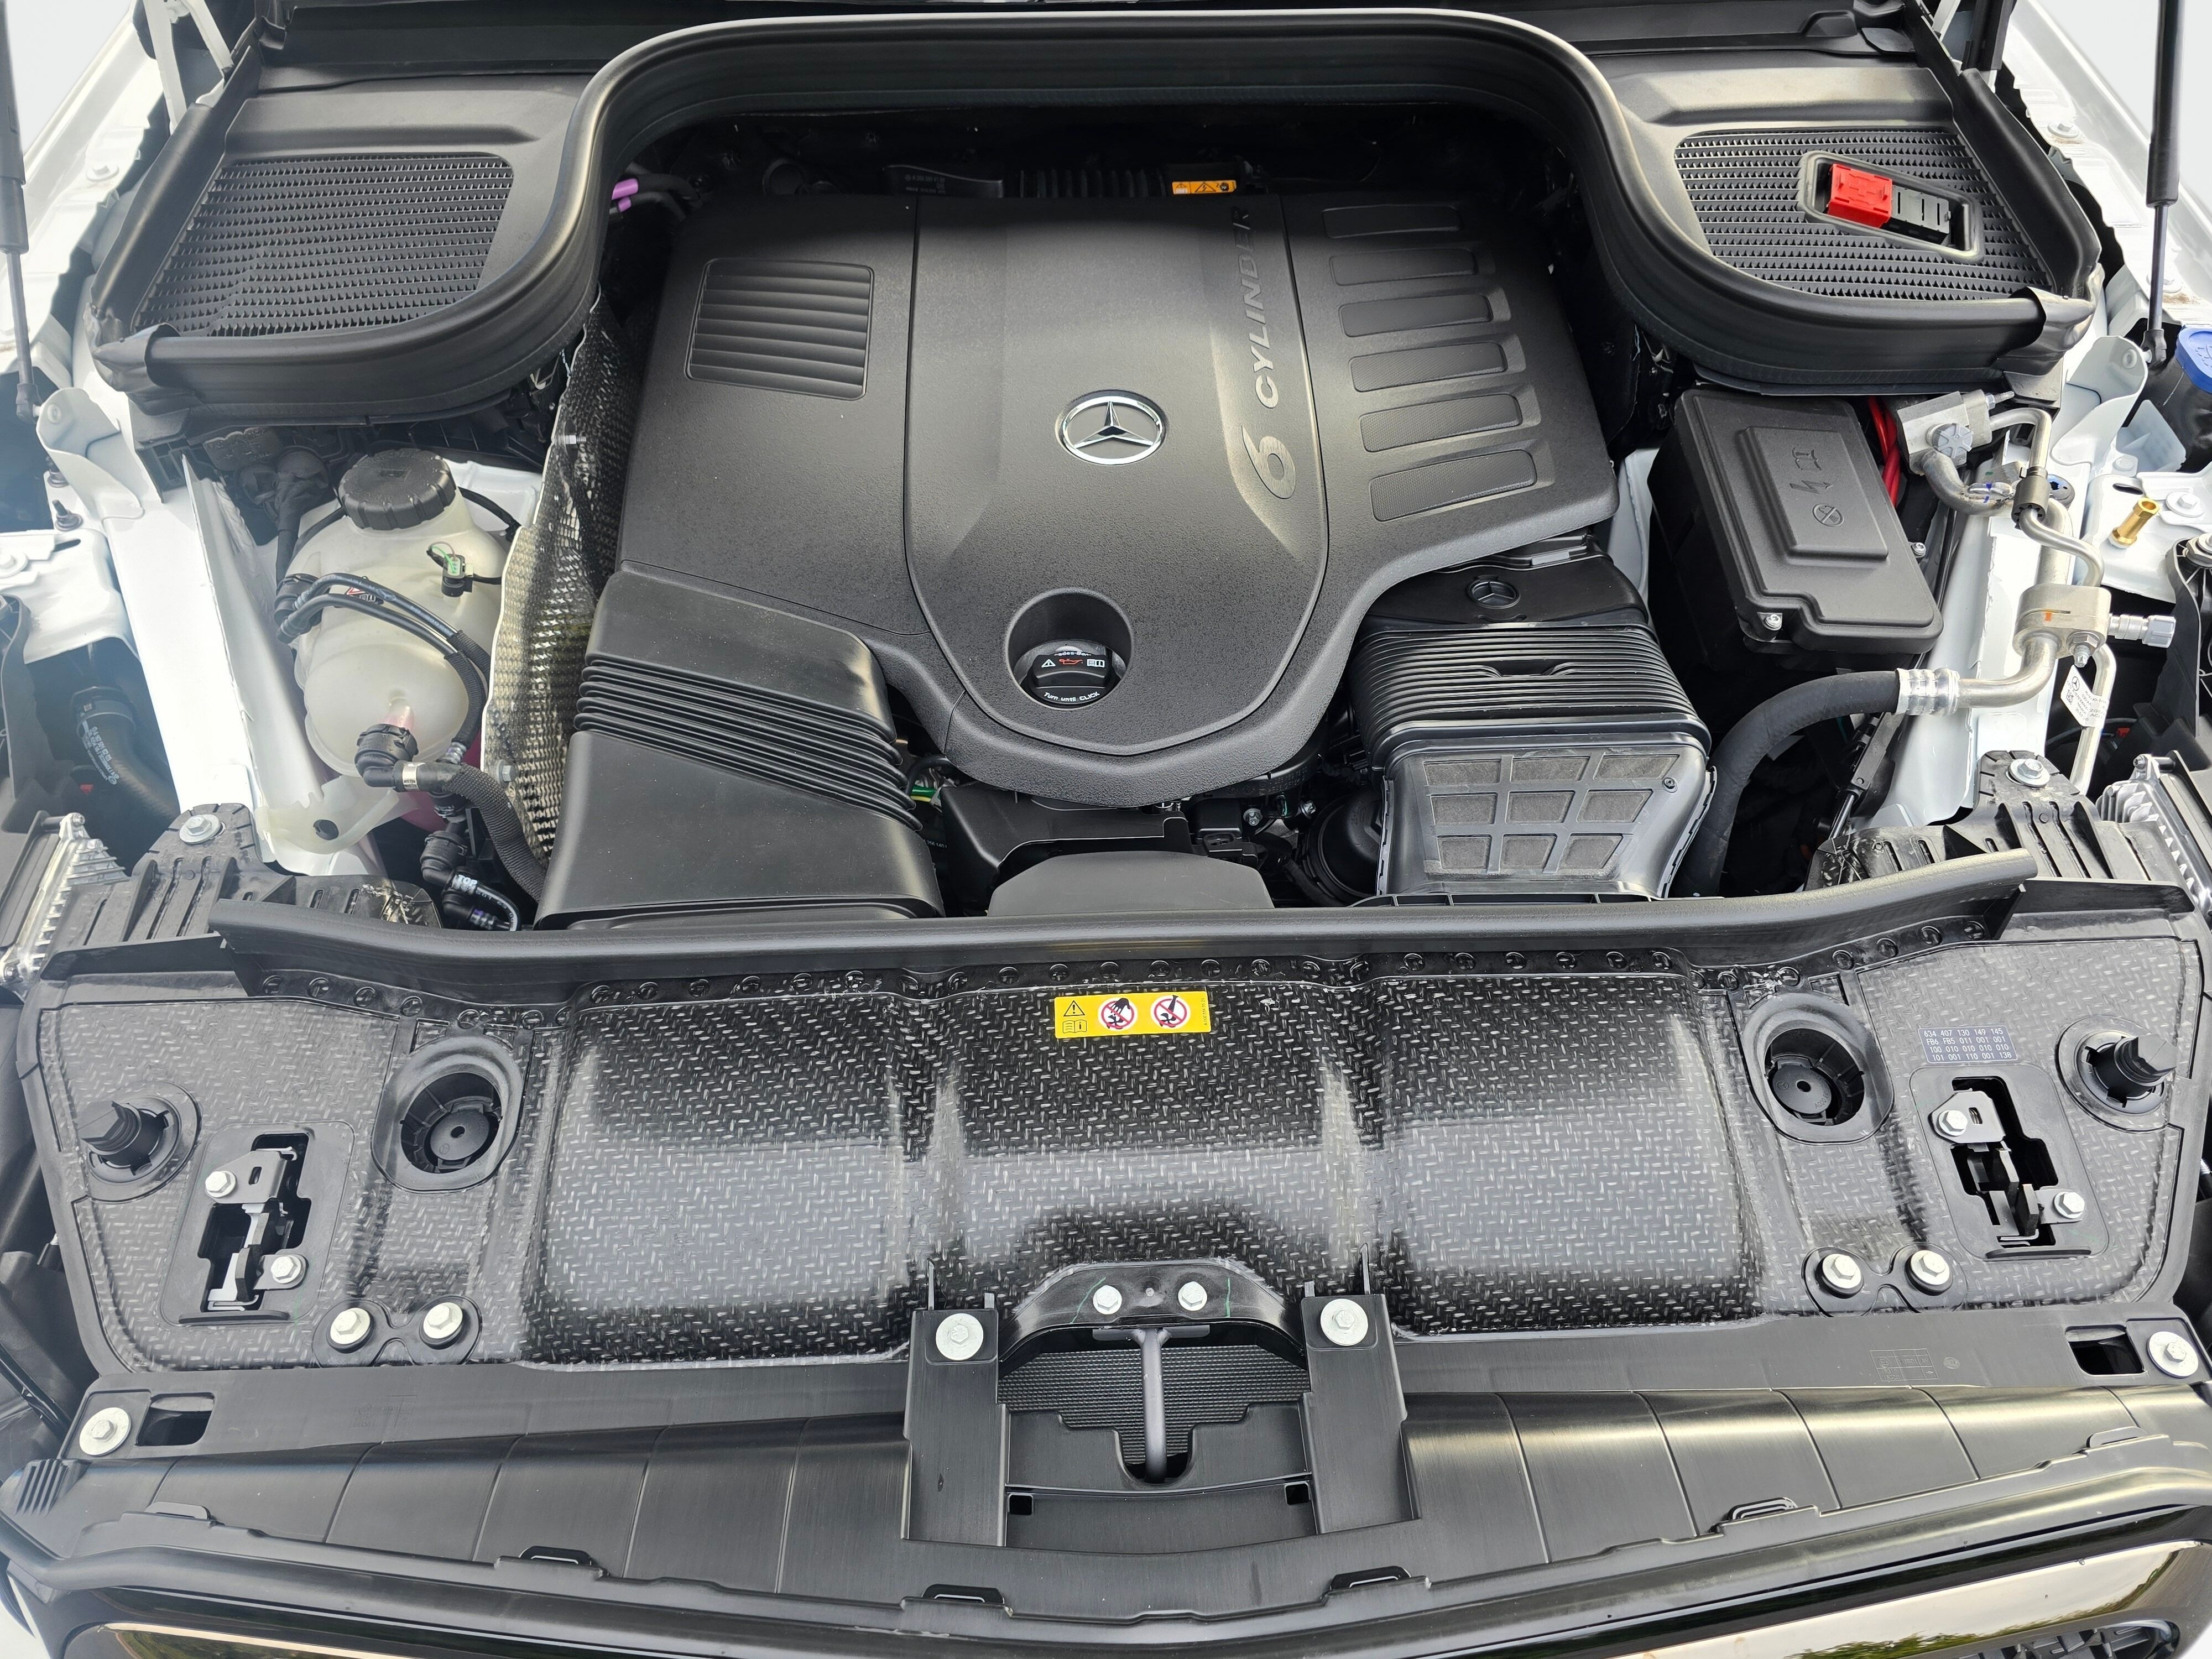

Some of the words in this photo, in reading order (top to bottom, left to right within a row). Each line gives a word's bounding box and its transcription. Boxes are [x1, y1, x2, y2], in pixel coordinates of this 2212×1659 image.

[1231, 206, 1278, 408] CYLINDER
[1241, 425, 1296, 499] 6
[1044, 692, 1059, 700] Turn
[1079, 691, 1100, 701] CLICK
[458, 874, 478, 886] TOP
